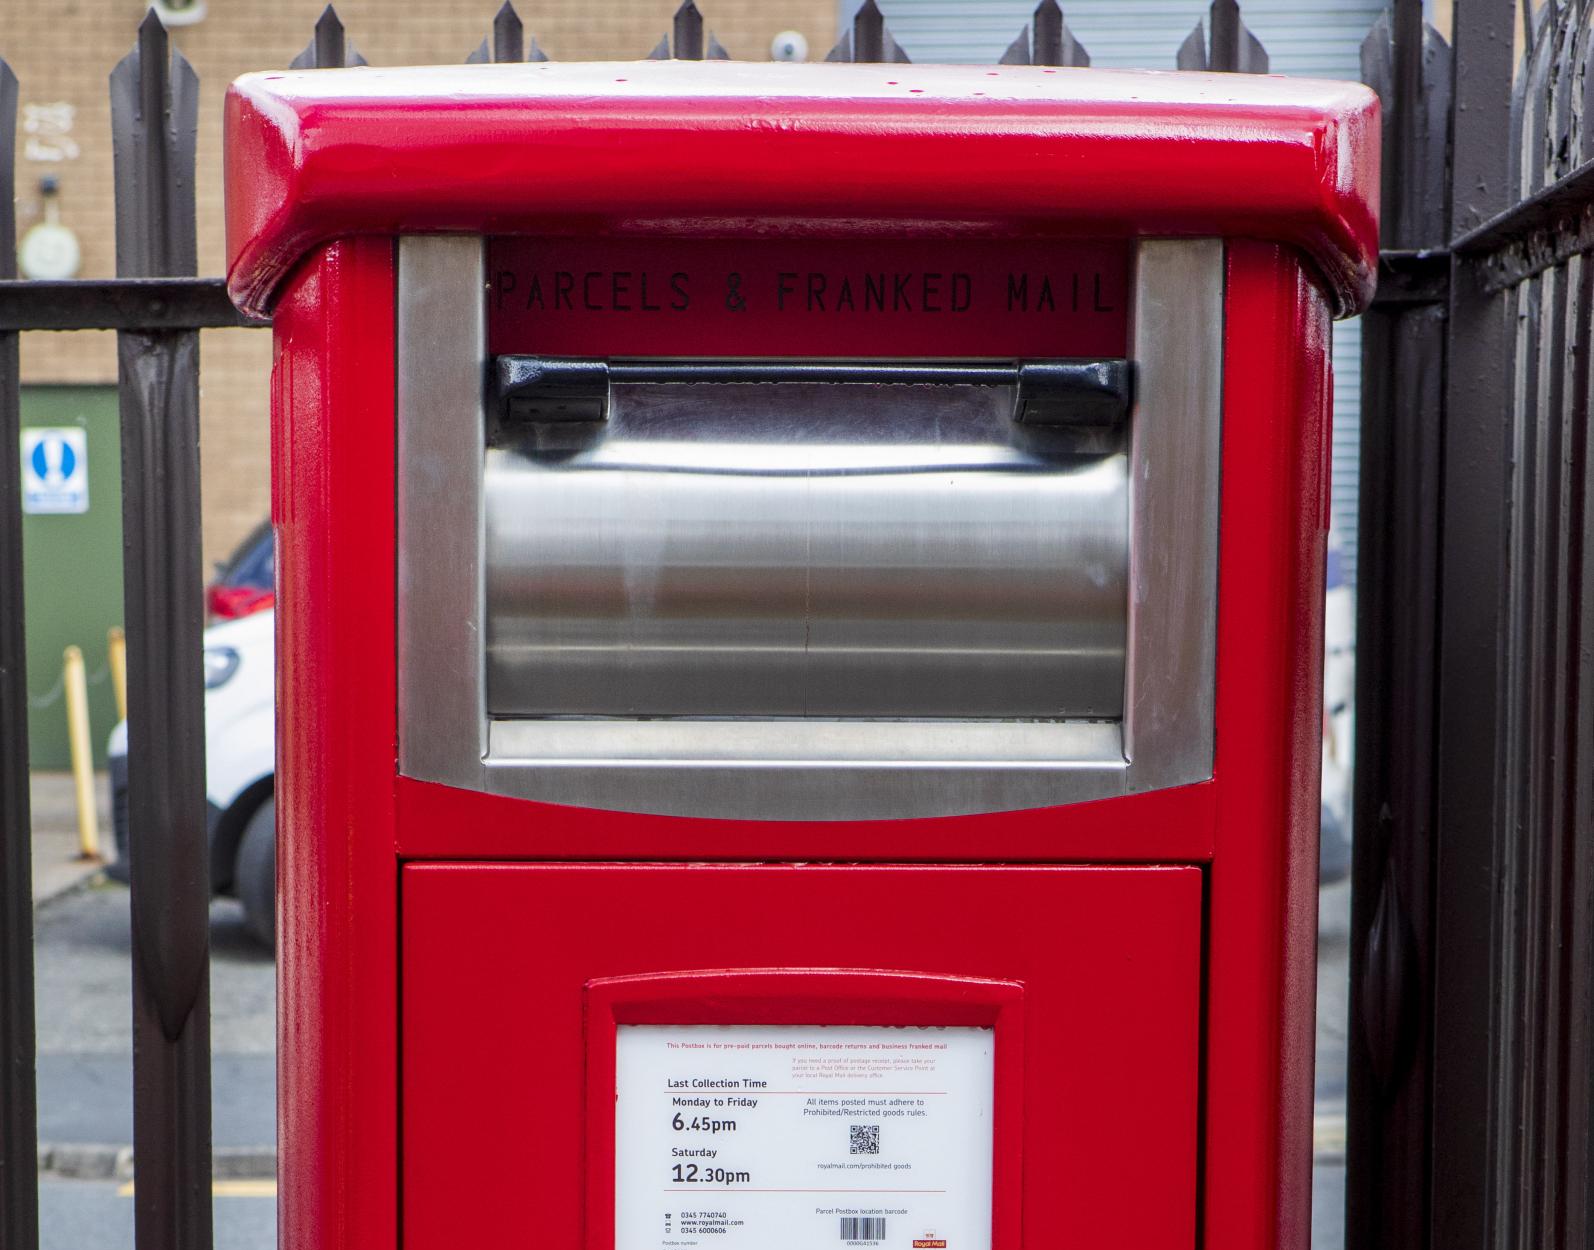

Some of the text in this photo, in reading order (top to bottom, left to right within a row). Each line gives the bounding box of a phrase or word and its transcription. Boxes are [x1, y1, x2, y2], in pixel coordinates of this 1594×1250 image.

[497, 271, 1115, 312] PARCELS & FRANKED MAIL
[724, 1042, 750, 1050] pre-paid
[752, 1042, 772, 1050] parcels
[774, 1042, 796, 1050] bought
[667, 1078, 767, 1088] Last Collection Time
[672, 1097, 758, 1108] Monday to Friday
[841, 1098, 866, 1108] posted
[804, 1108, 928, 1118] Prohibited/Restricted goods rules.
[672, 1112, 736, 1134] 6.45pm
[672, 1147, 718, 1158] Saturday
[672, 1163, 750, 1186] 12.30pm
